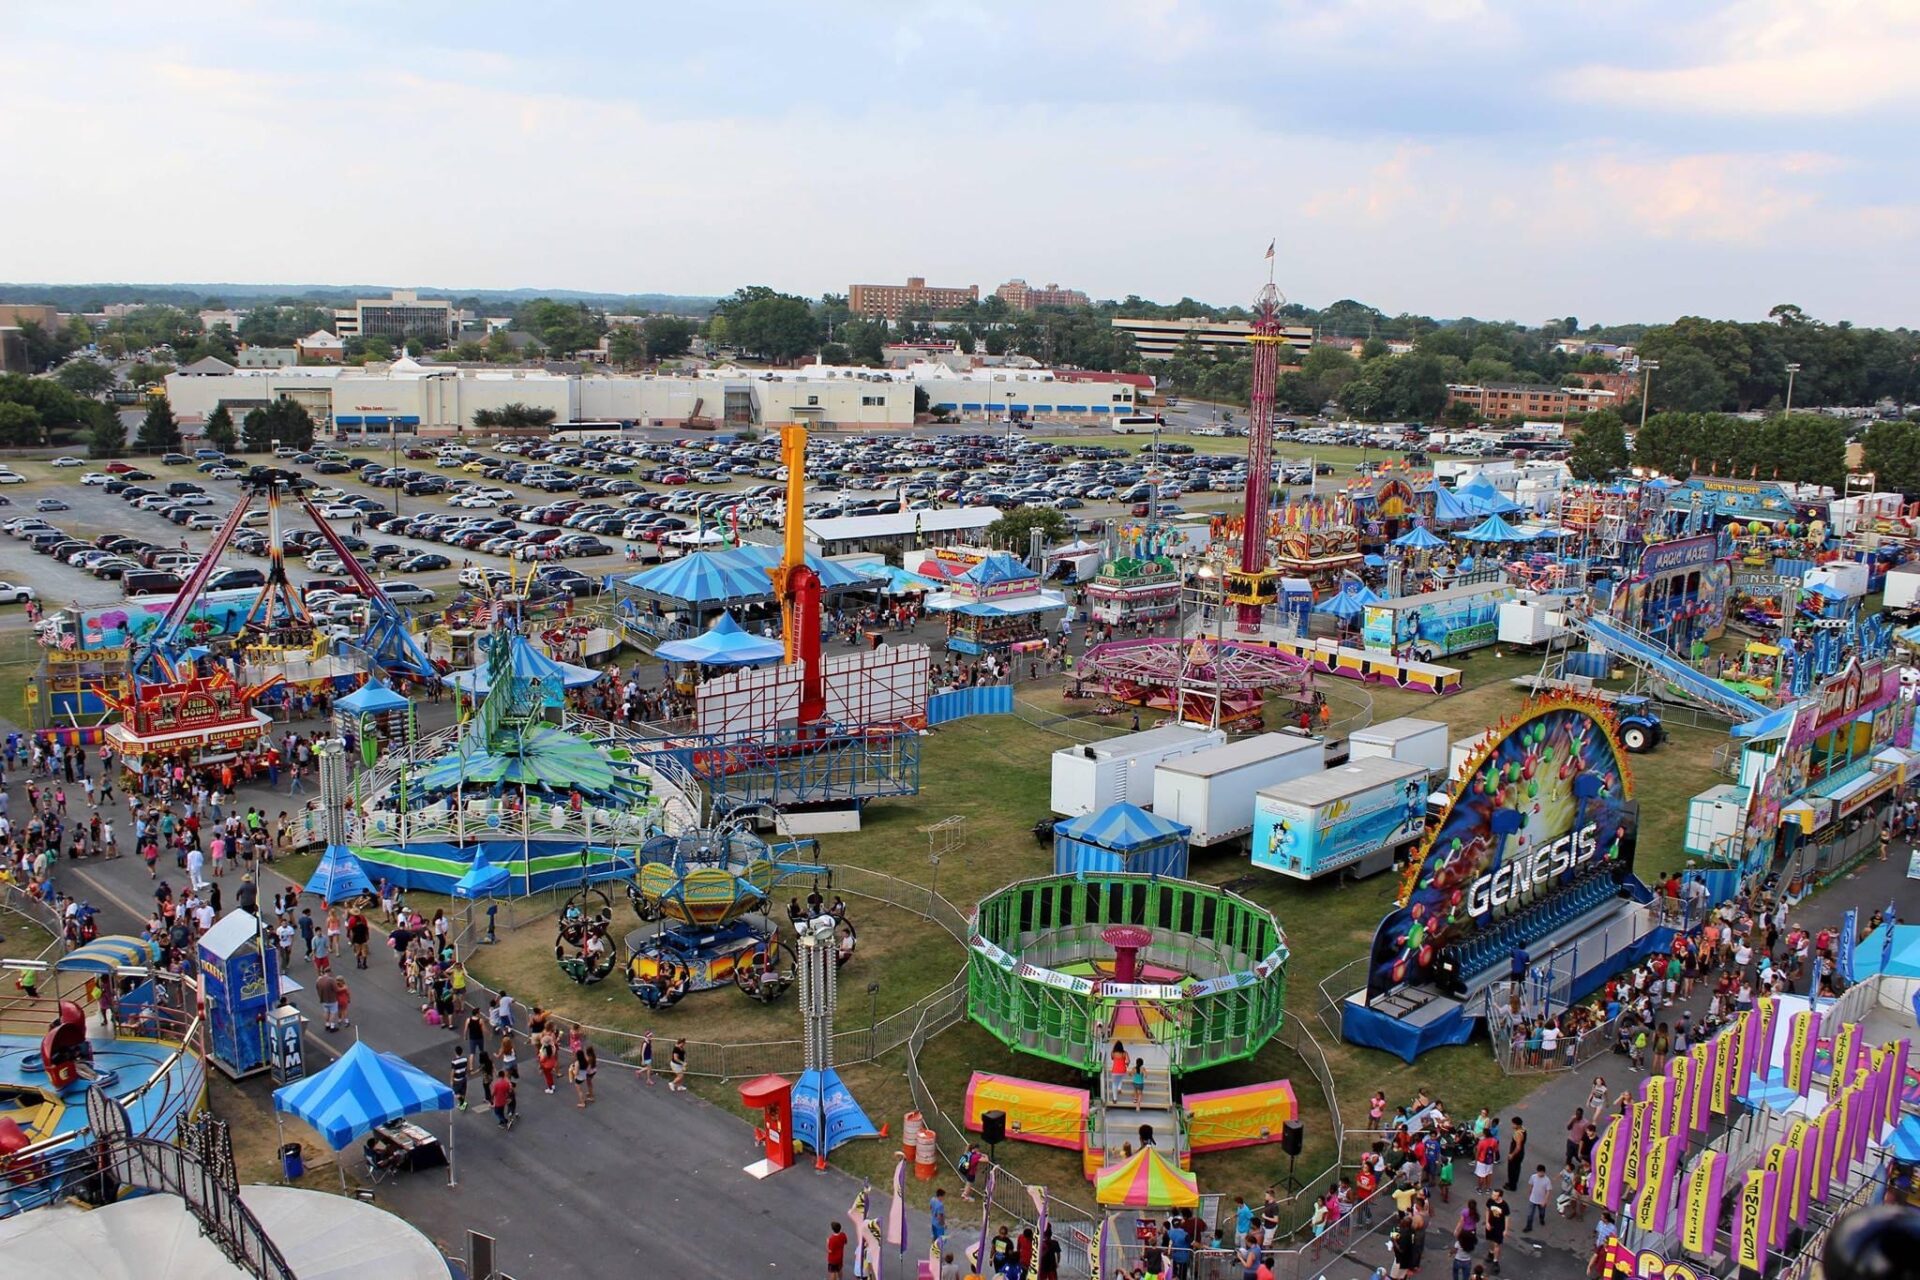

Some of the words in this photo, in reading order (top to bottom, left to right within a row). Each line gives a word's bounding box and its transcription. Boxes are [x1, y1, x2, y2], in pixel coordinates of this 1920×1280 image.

[1704, 483, 1735, 493] HAUNTED
[1737, 486, 1760, 494] HOUSE
[1655, 551, 1682, 568] MAGIC
[1685, 545, 1708, 562] MAZE
[1736, 574, 1801, 586] MONSTER
[187, 700, 207, 709] FRIED
[182, 707, 214, 717] DOUGH
[210, 731, 240, 741] ELEPHANT
[243, 727, 259, 735] EARS
[152, 739, 177, 749] FUNNEL
[179, 737, 199, 746] CAKES
[1467, 822, 1597, 918] GENESIS
[201, 959, 224, 983] TICKETS
[270, 1026, 281, 1068] ATM
[284, 1026, 301, 1068] ATM
